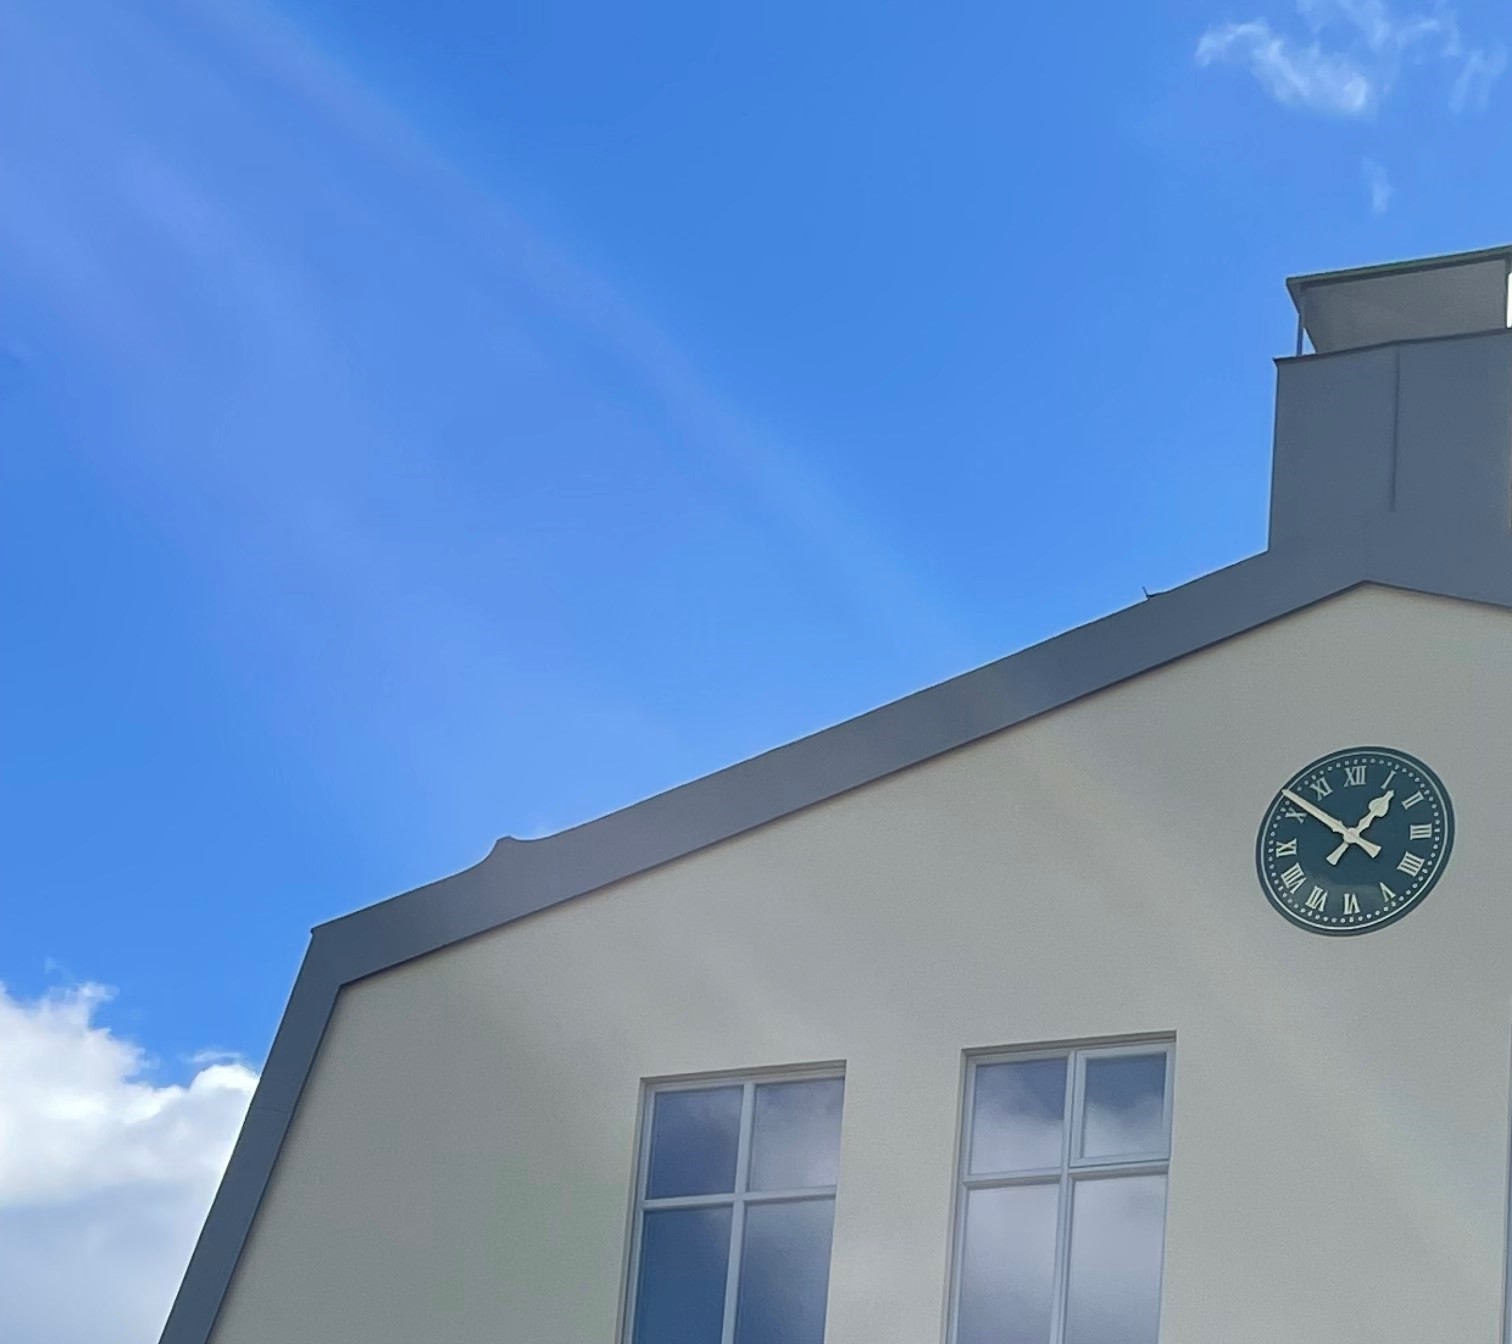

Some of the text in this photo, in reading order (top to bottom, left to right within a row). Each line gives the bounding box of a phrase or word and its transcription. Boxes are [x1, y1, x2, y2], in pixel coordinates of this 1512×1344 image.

[1344, 765, 1367, 787] XII
[1380, 770, 1396, 789] I
[1309, 777, 1333, 801] XI
[1401, 791, 1424, 810] II
[1284, 807, 1307, 824] X
[1409, 823, 1433, 840] III
[1275, 838, 1297, 858] IX
[1396, 851, 1425, 877] IIII
[1280, 862, 1307, 894] VIII
[1304, 886, 1329, 912] VII
[1379, 882, 1397, 902] V
[1344, 893, 1360, 915] VI
